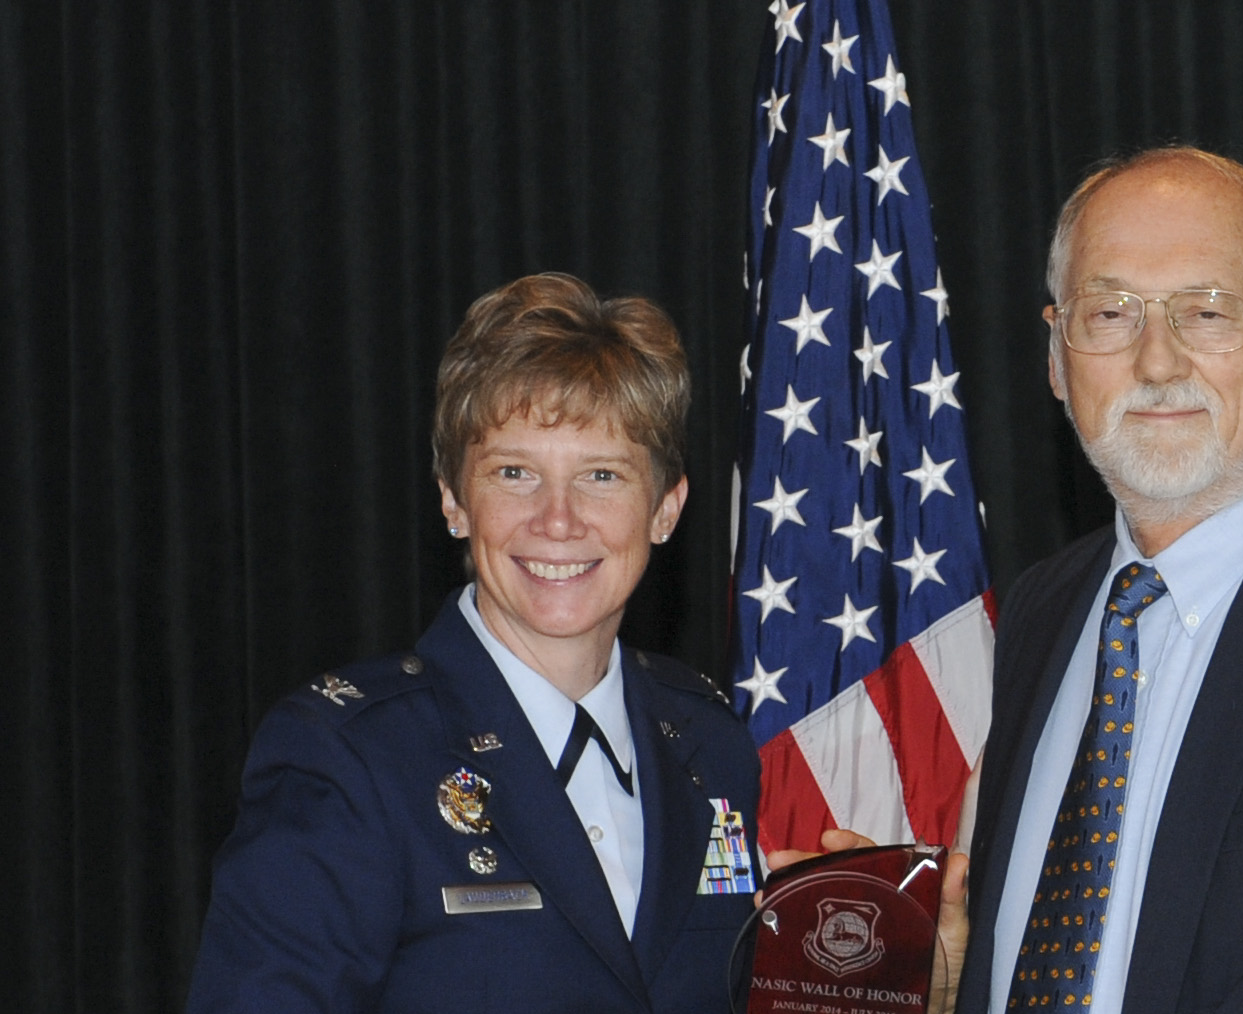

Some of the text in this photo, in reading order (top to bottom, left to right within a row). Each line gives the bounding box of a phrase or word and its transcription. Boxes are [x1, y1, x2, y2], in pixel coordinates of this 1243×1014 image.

[751, 977, 922, 1006] NASIC WALL OF HONOR
[772, 1000, 819, 1012] JANUARY
[820, 1005, 842, 1014] 2014
